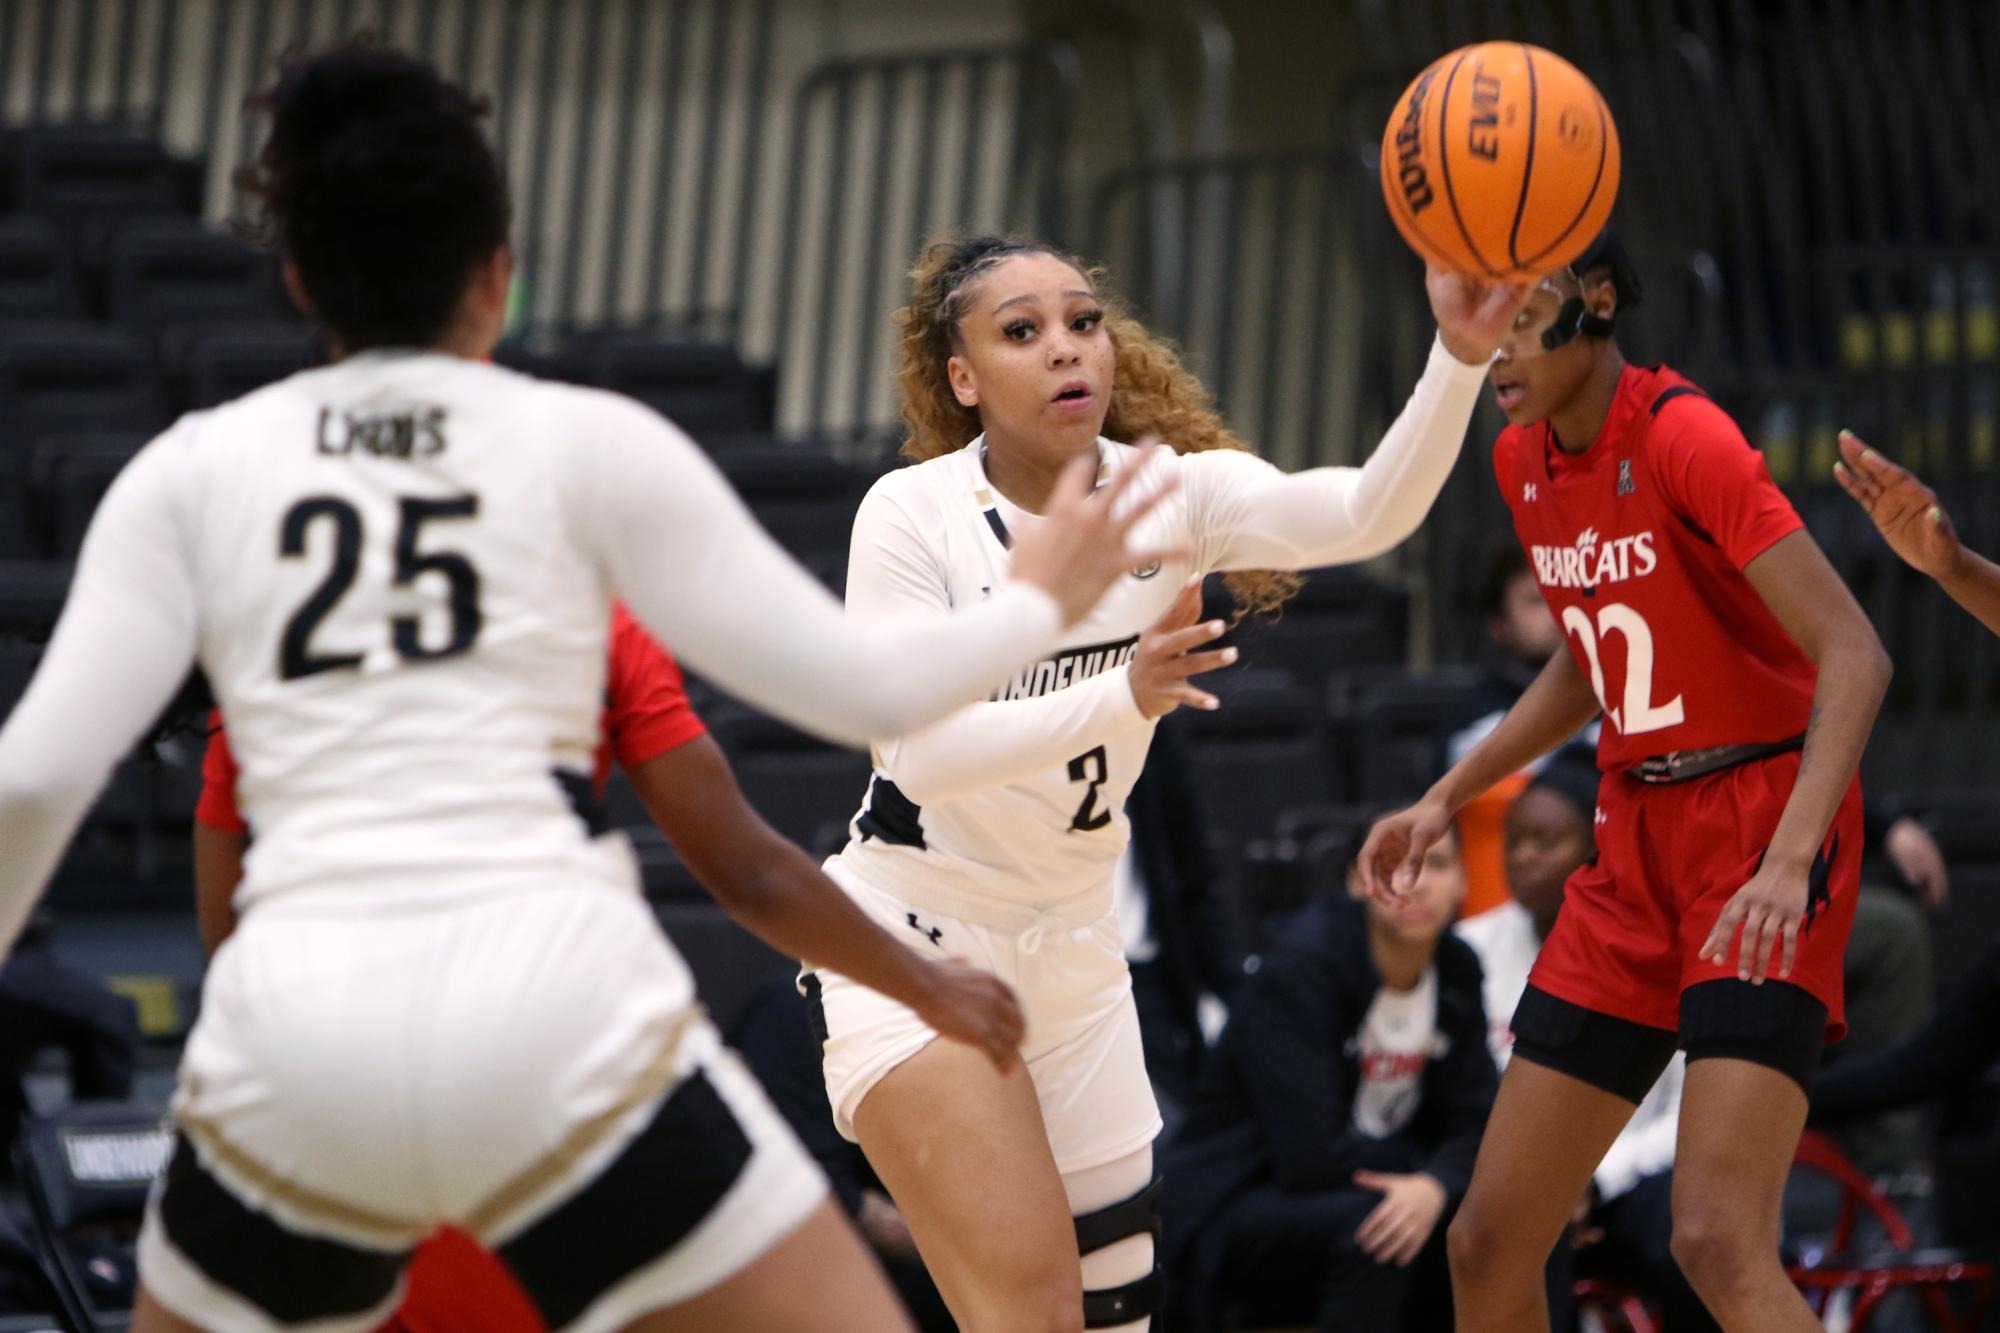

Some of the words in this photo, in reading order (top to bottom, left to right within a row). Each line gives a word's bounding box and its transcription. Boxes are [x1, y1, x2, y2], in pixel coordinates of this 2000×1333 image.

[278, 493, 485, 684] 25
[1531, 528, 1657, 588] BEARCATS
[1066, 744, 1112, 833] 2
